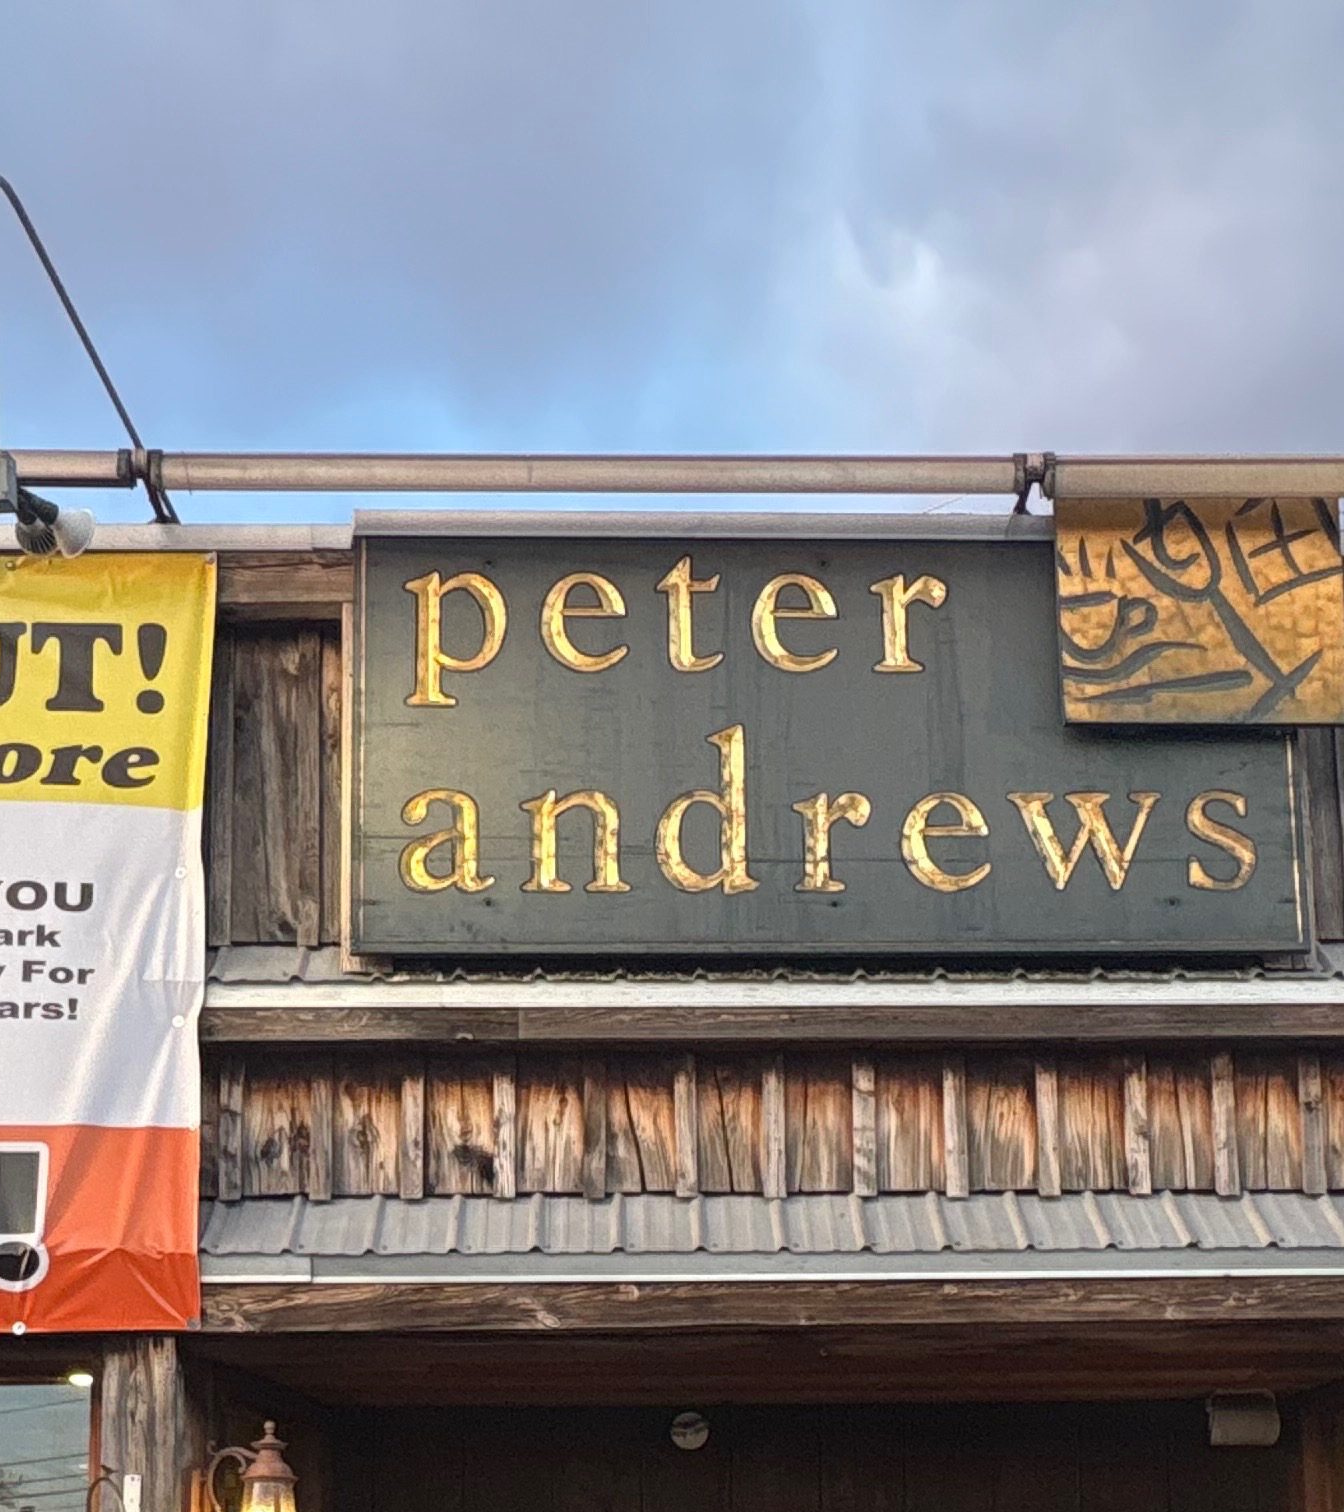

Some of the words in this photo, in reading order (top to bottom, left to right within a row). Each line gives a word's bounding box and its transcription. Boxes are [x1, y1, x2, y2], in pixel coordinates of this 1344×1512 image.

[403, 553, 949, 708] peter
[398, 722, 1257, 895] andrews
[22, 960, 94, 987] For
